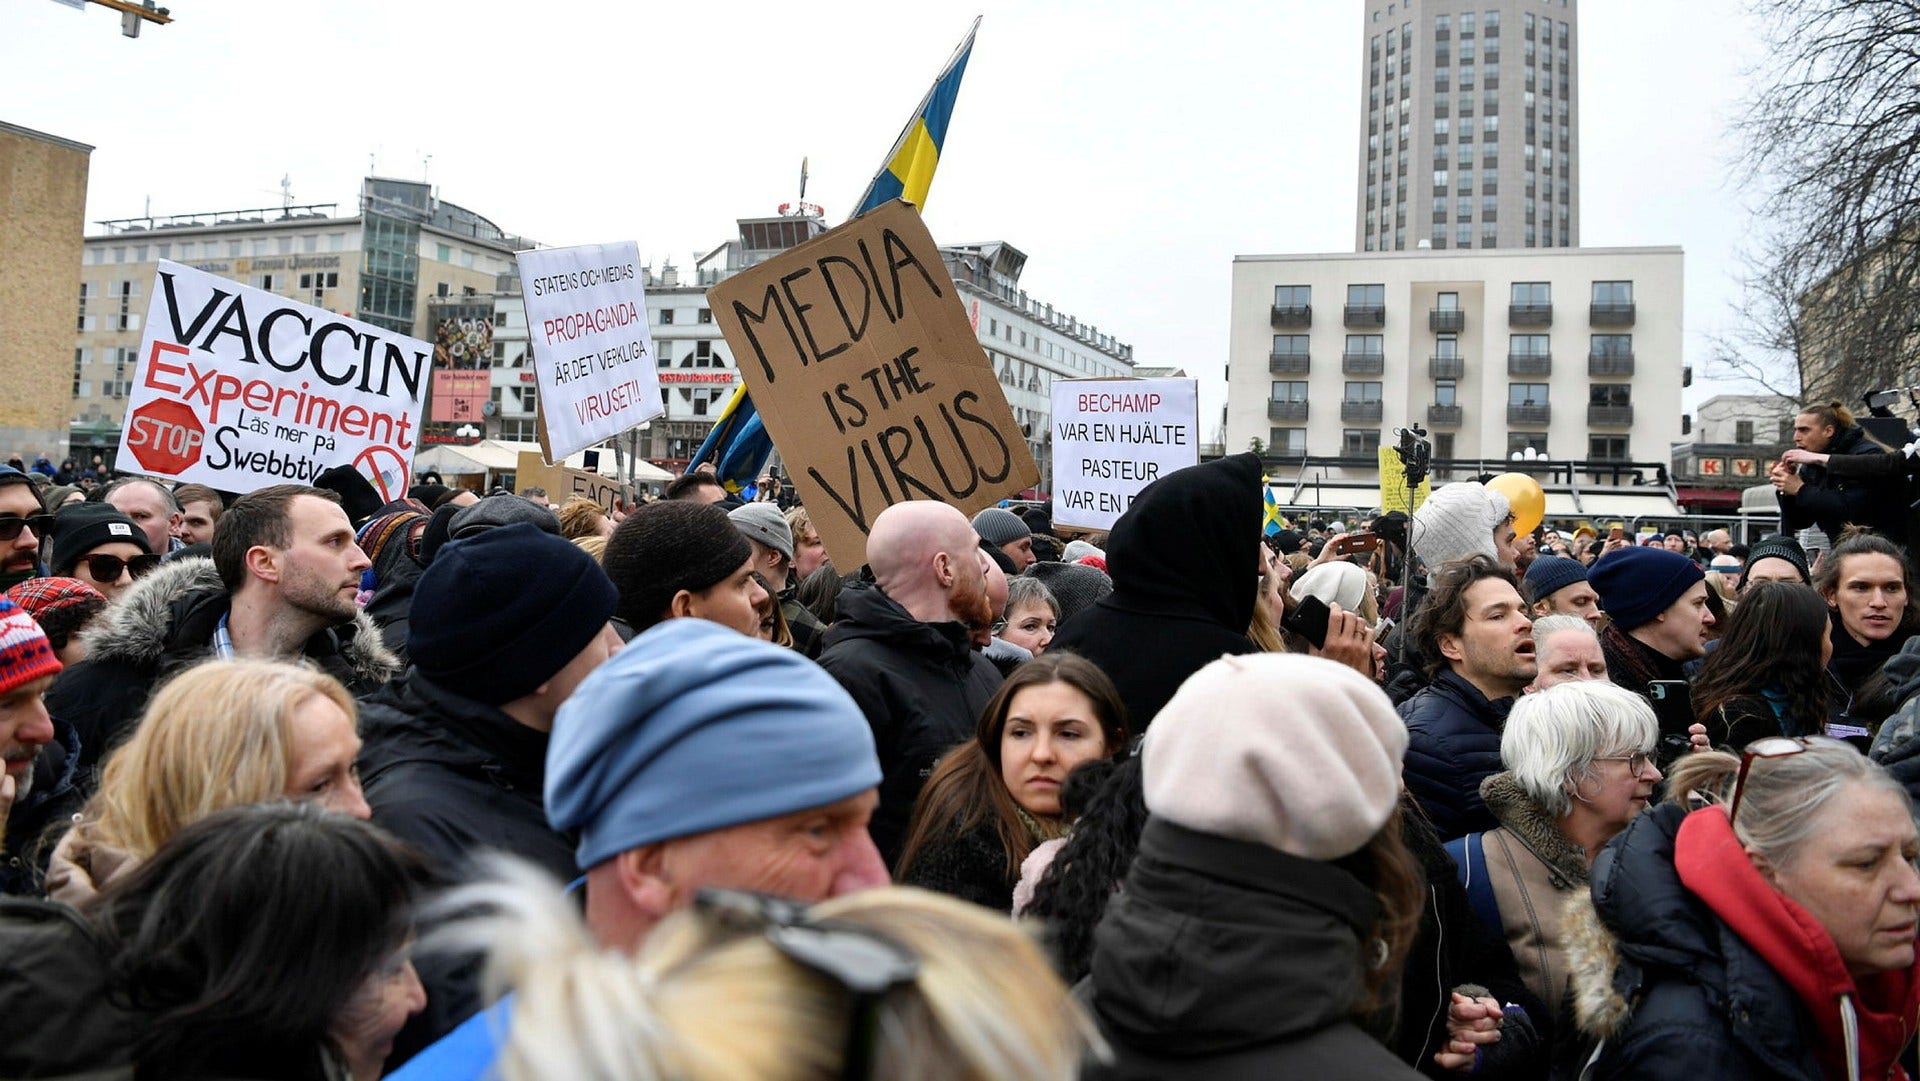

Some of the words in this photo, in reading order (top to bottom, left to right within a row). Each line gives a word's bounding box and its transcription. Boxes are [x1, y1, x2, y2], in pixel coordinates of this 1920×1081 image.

[534, 272, 578, 296] STATENS
[580, 269, 600, 287] OCH
[601, 264, 634, 284] MEDIAS
[544, 302, 639, 346] PROPAGANDA
[732, 228, 942, 384] MEDIA
[157, 271, 428, 403] VACCIN
[555, 361, 572, 386] ÄR
[572, 354, 594, 380] DET
[597, 340, 647, 371] VERKLIGA
[144, 340, 412, 451] Experiment
[575, 380, 641, 426] VIRUSET!!
[822, 383, 868, 434] IS
[862, 347, 935, 410] THE
[1078, 393, 1161, 413] BECHAMP
[128, 416, 203, 459] STOP
[238, 409, 270, 435] Läs
[275, 422, 308, 444] mer
[1058, 423, 1089, 442] VAR
[1093, 423, 1115, 442] EN
[1120, 421, 1186, 446] HJÄLTE
[206, 425, 324, 484] Swebbtv
[807, 390, 1011, 537] VIRUS
[1082, 459, 1159, 481] PASTEUR
[1062, 489, 1095, 511] VAR
[1099, 492, 1121, 513] EN
